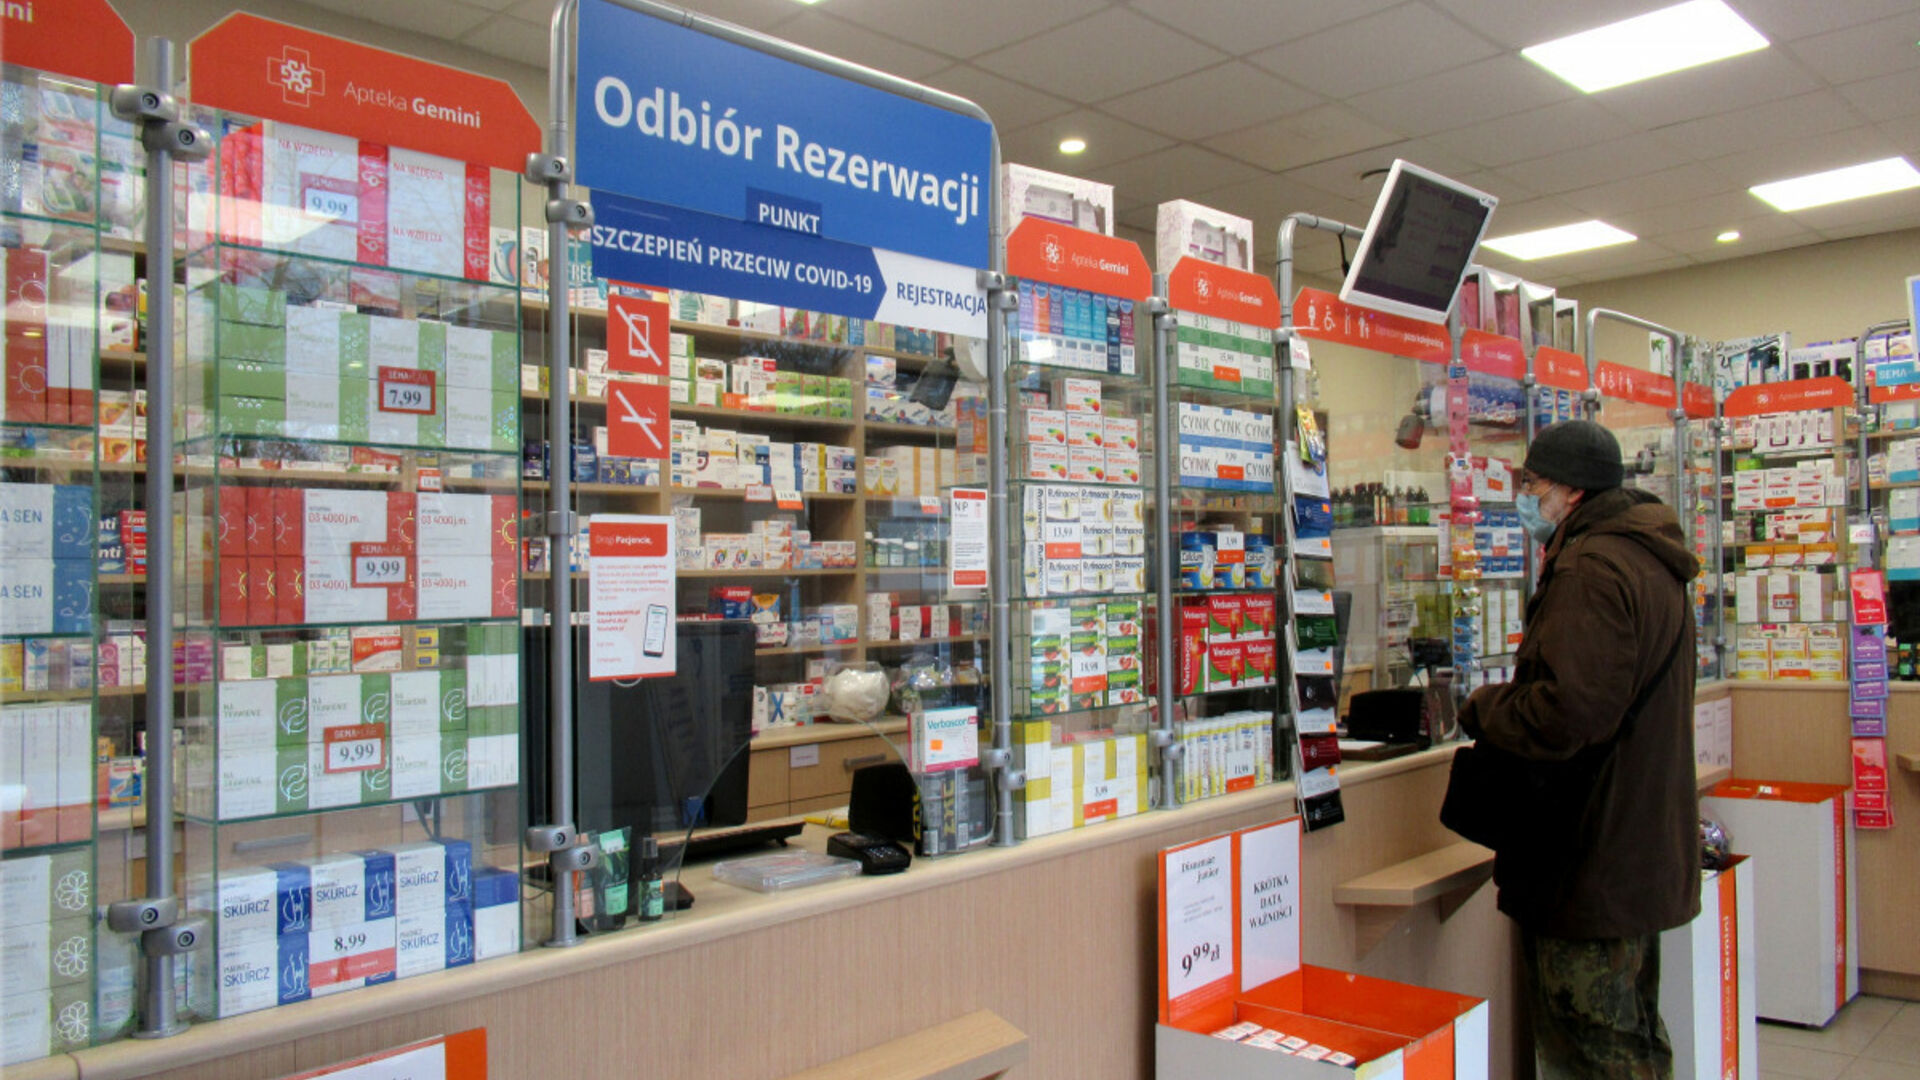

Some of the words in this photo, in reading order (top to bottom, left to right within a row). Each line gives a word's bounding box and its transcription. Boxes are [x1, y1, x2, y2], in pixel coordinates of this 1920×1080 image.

[0, 1, 33, 22] ni
[344, 81, 407, 110] Apteka
[412, 97, 481, 128] Gemini
[594, 76, 762, 160] Odbiór
[777, 124, 979, 224] Rezerwacji
[312, 195, 348, 216] 9,99
[759, 203, 820, 234] PUNKT
[592, 226, 702, 264] SZCZEPIEŃ
[709, 246, 789, 280] PRZECIW
[794, 263, 873, 294] COVID-19
[1071, 253, 1098, 268] Apteka
[1100, 258, 1129, 276] Gemini
[896, 282, 987, 316] REJESTRACJA
[1239, 292, 1263, 307] Gemini
[389, 389, 422, 406] 7,99
[1181, 415, 1210, 431] CYNK
[1214, 418, 1242, 435] CYNK
[1245, 423, 1271, 438] CYNK
[1182, 456, 1211, 472] CYNK
[1246, 462, 1271, 477] CYNK
[14, 509, 42, 523] SEN
[366, 561, 400, 578] 9,99
[14, 584, 42, 598] SEN
[340, 743, 375, 762] 9,99
[400, 871, 439, 888] SKURCZ
[316, 885, 359, 902] SKURCZ
[1260, 893, 1282, 909] DATA
[223, 900, 270, 919] SKURCZ
[333, 933, 367, 951] 8,99
[400, 933, 440, 951] SKURCZ
[1723, 915, 1731, 981] Gemini
[224, 966, 270, 988] SKURCZ
